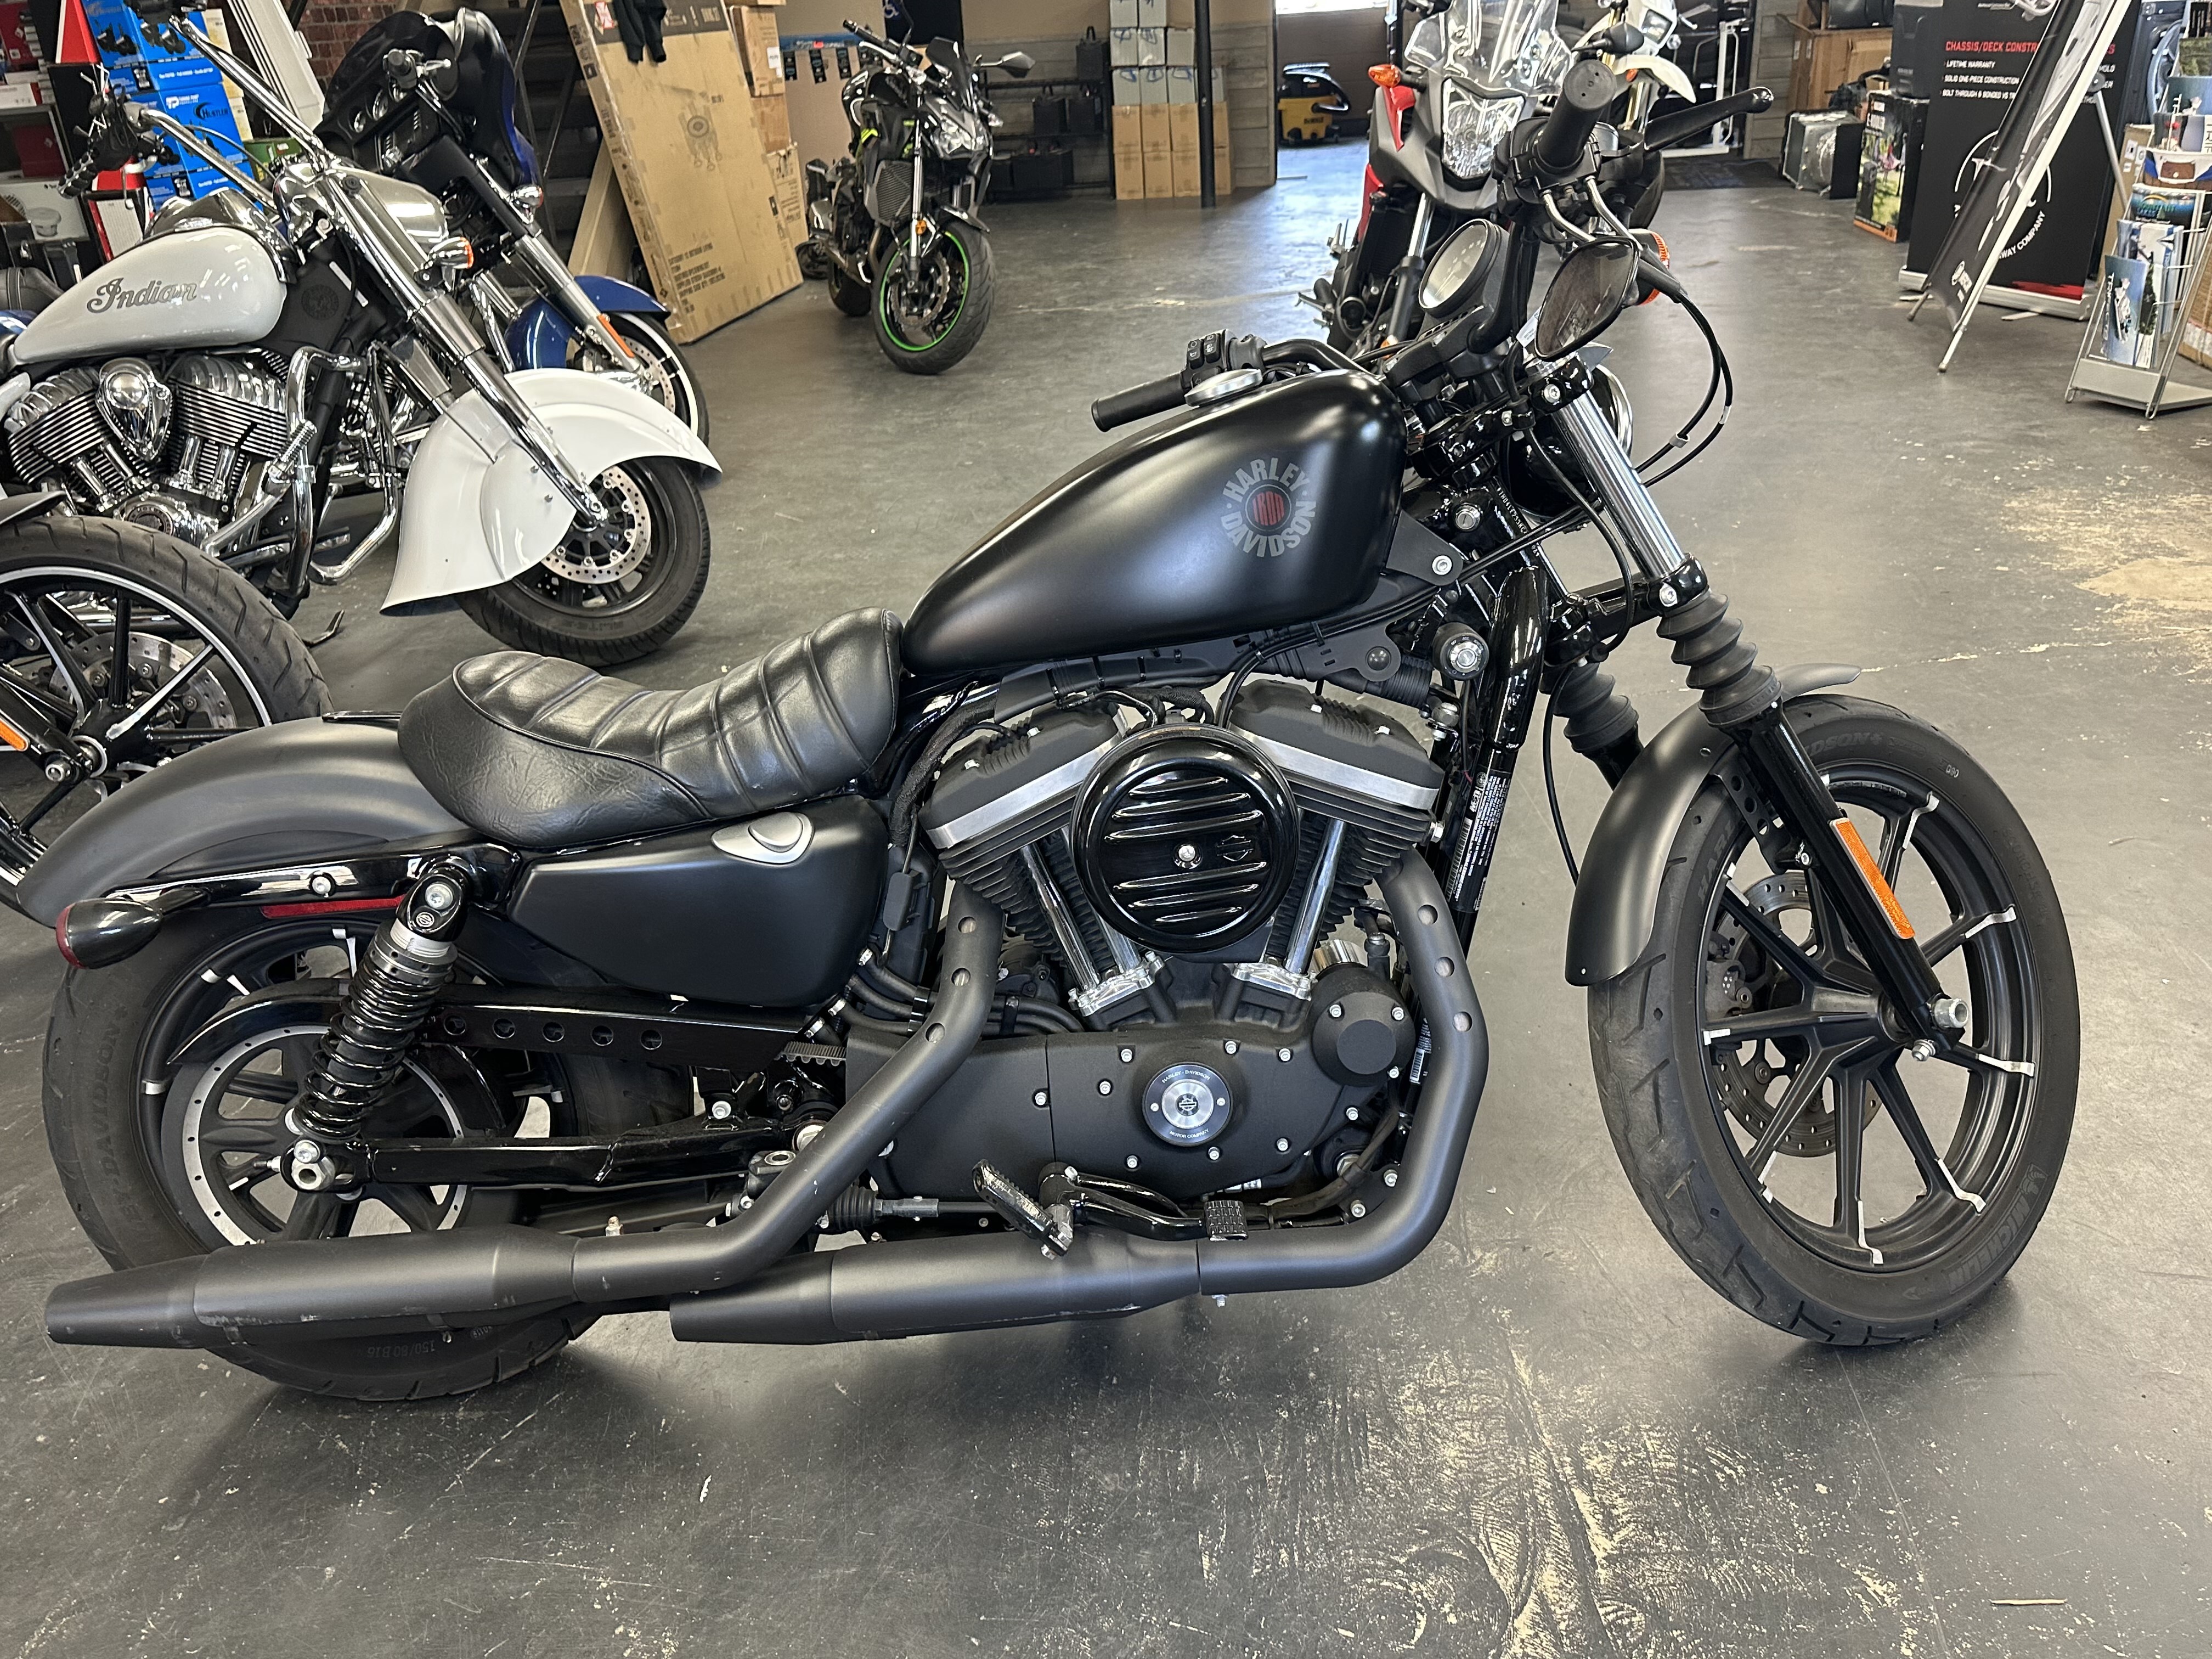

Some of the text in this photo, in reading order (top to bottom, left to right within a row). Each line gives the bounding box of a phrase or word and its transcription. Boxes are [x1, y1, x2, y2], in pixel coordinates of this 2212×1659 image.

[1945, 41, 2039, 53] CHASSIS/DECK CONSTR
[2017, 210, 2045, 250] COMPANY
[87, 277, 198, 314] Indian
[1222, 458, 1310, 503] HARLEY
[1251, 491, 1285, 526] IRON
[1221, 499, 1316, 557] DAVIDSON
[1161, 1070, 1211, 1084] HARLEY DAVIDSON
[1169, 1128, 1209, 1138] MOTOR COMPANY
[1948, 1195, 2030, 1290] MICHELIN
[393, 1340, 436, 1358] 150/80
